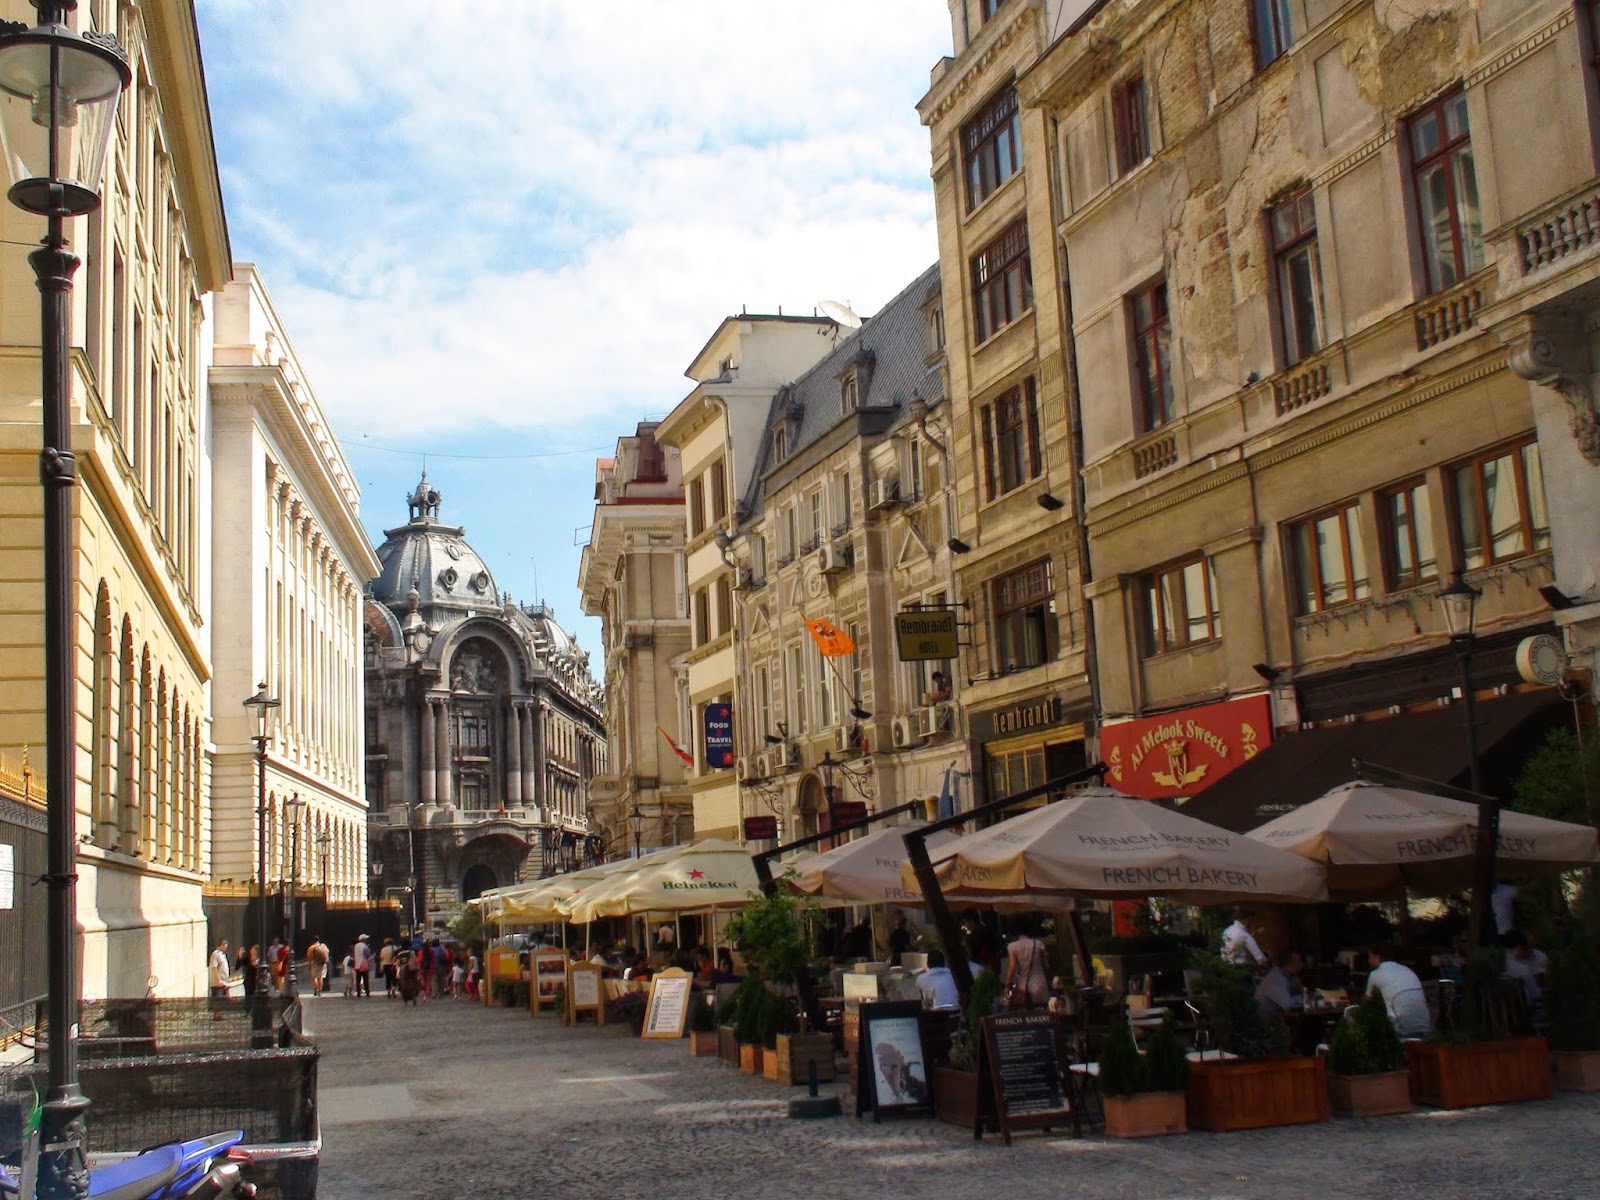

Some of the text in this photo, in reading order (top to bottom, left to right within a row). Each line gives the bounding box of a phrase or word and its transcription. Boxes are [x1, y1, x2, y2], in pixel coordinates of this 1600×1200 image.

[919, 641, 939, 654] HOTEL
[1142, 719, 1185, 753] Melook
[1186, 719, 1230, 758] Sweets
[1077, 833, 1157, 846] FRENCH
[1161, 833, 1233, 847] BAKERY
[1396, 830, 1468, 857] FRENCH
[1102, 867, 1259, 886] FRENCH BAKERY
[661, 880, 738, 890] Heineken
[995, 1015, 1050, 1025] FRENCH BAKERY
